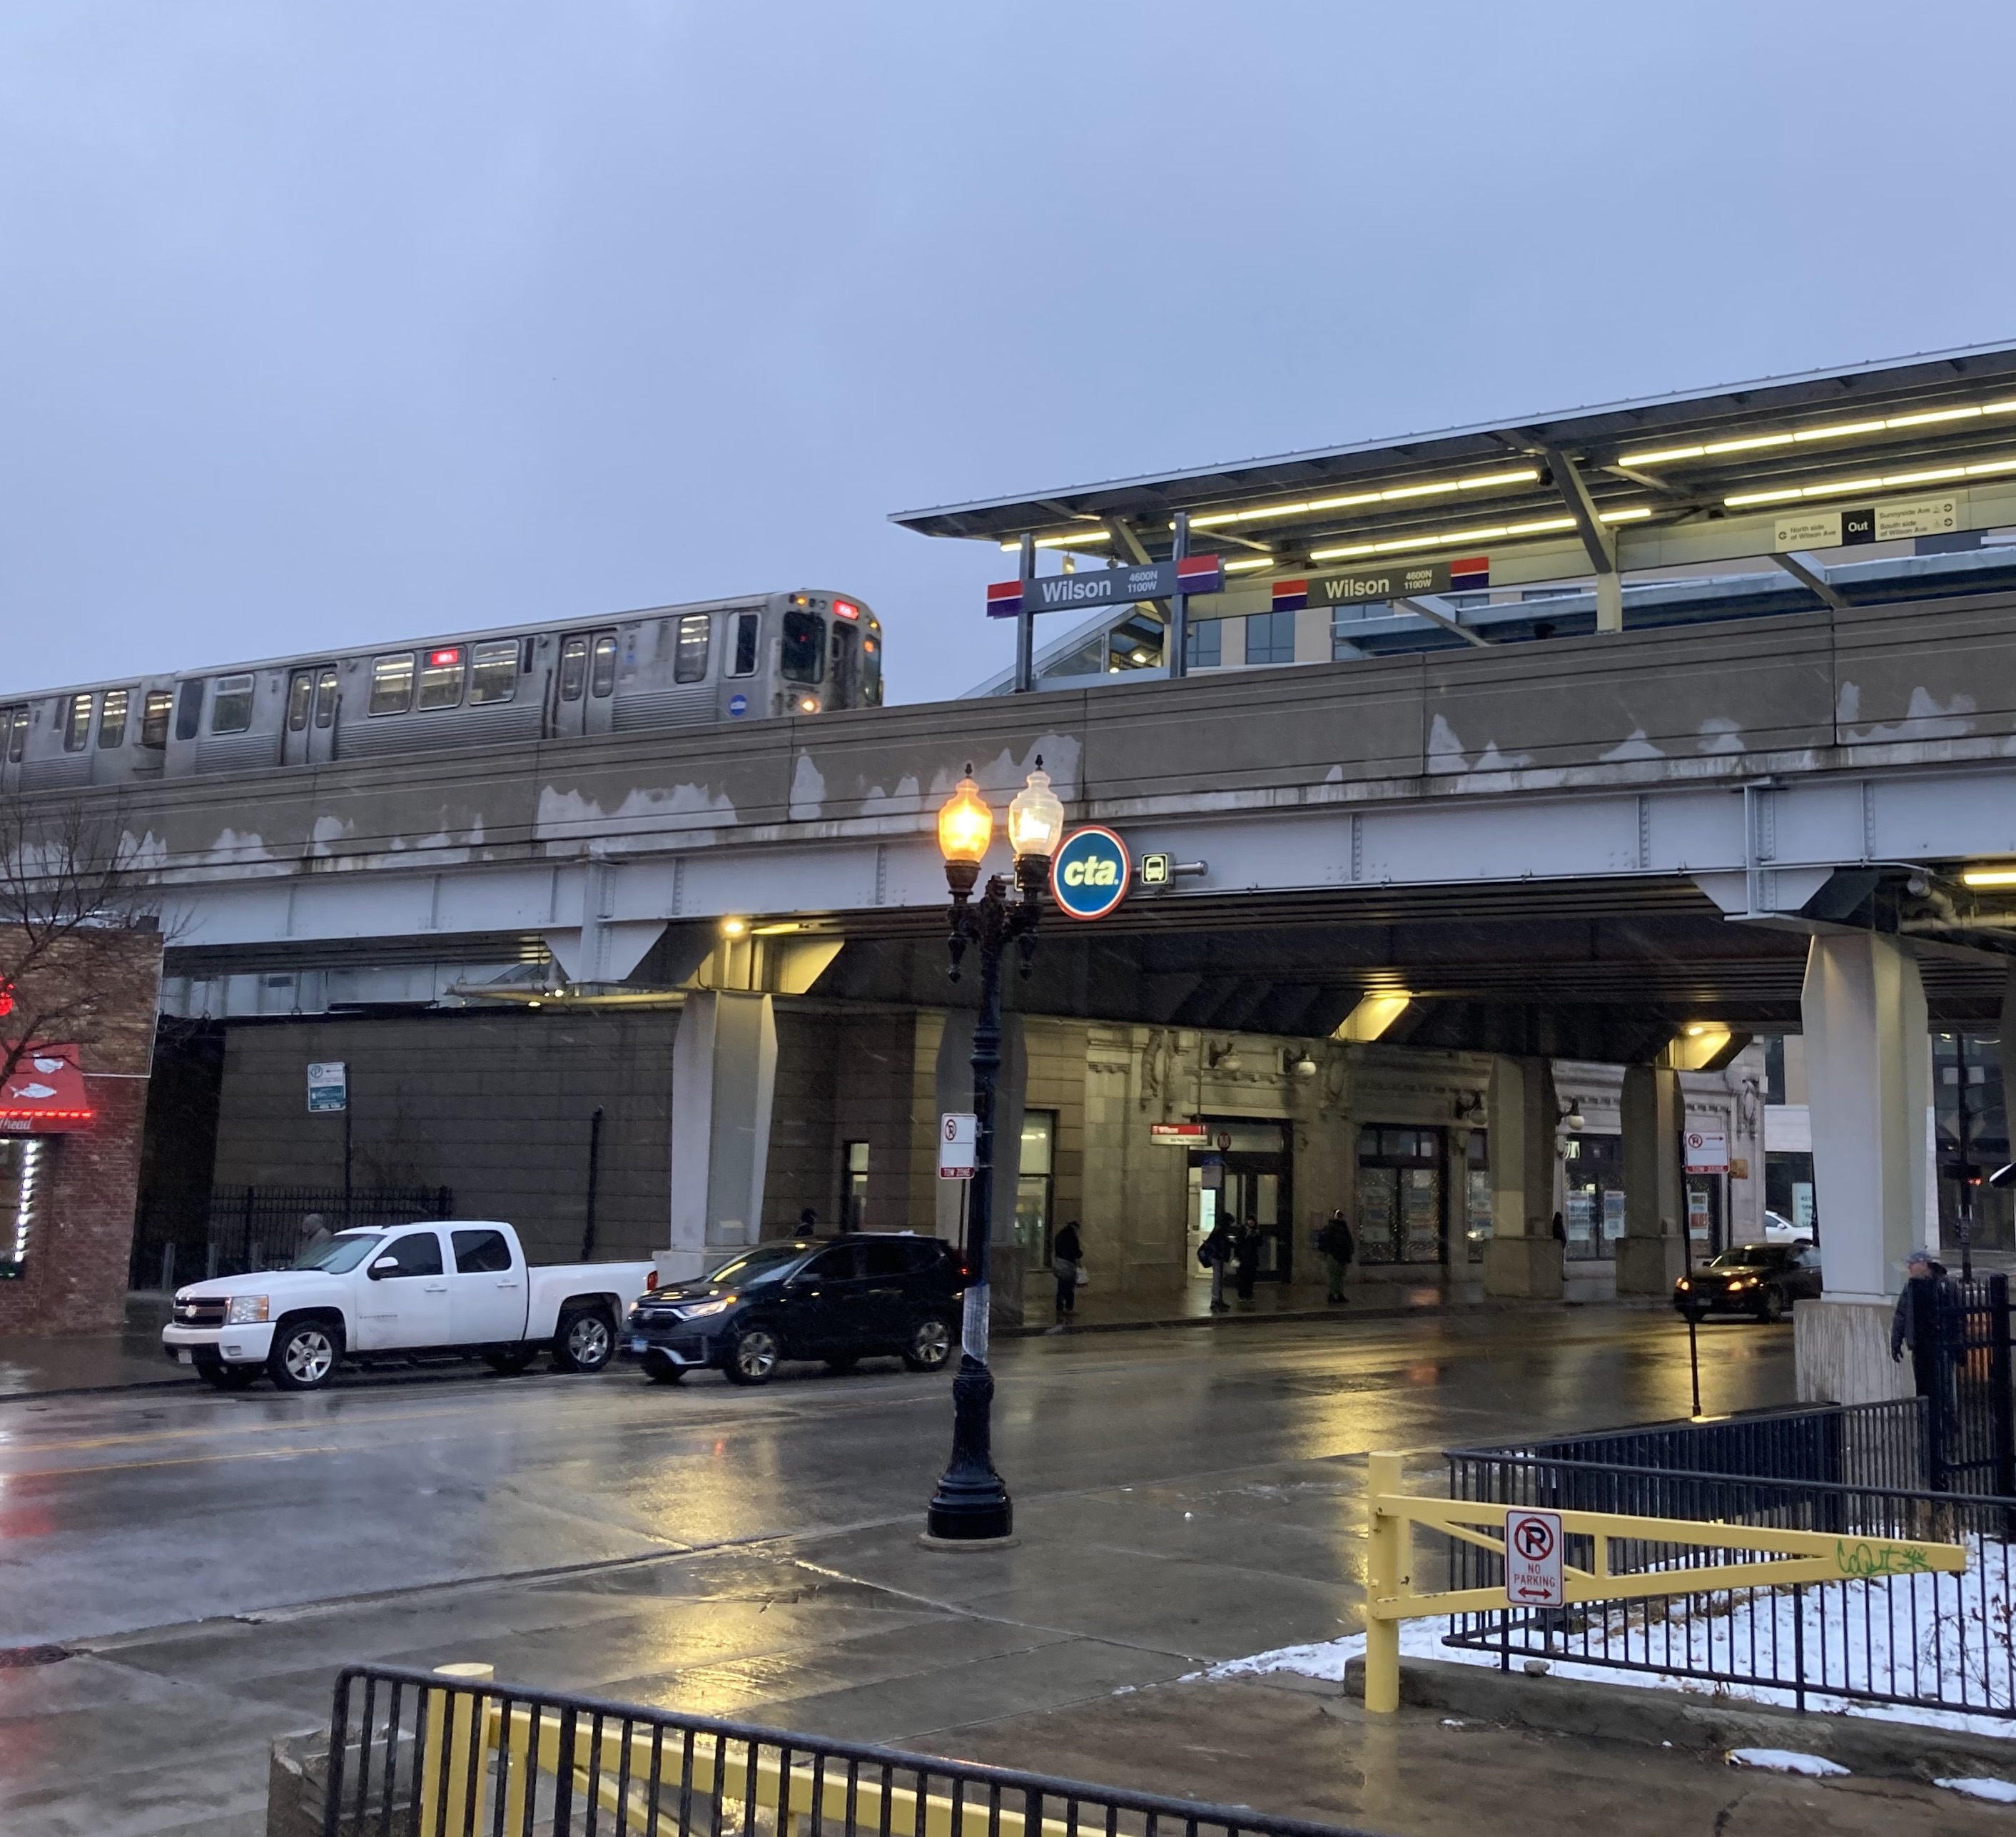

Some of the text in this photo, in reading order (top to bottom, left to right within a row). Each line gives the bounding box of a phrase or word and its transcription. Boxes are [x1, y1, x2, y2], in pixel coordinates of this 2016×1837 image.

[1880, 509, 1915, 518] Sunnyside
[1848, 521, 1868, 532] Out
[1042, 570, 1158, 603] Wilson 4600N
[1128, 581, 1157, 593] 1100W
[1326, 570, 1432, 599] Wilson 4600N
[1404, 580, 1432, 589] 1100W
[1064, 856, 1116, 886] cta
[1528, 1563, 1541, 1574] NO
[1514, 1573, 1556, 1587] PARKING
